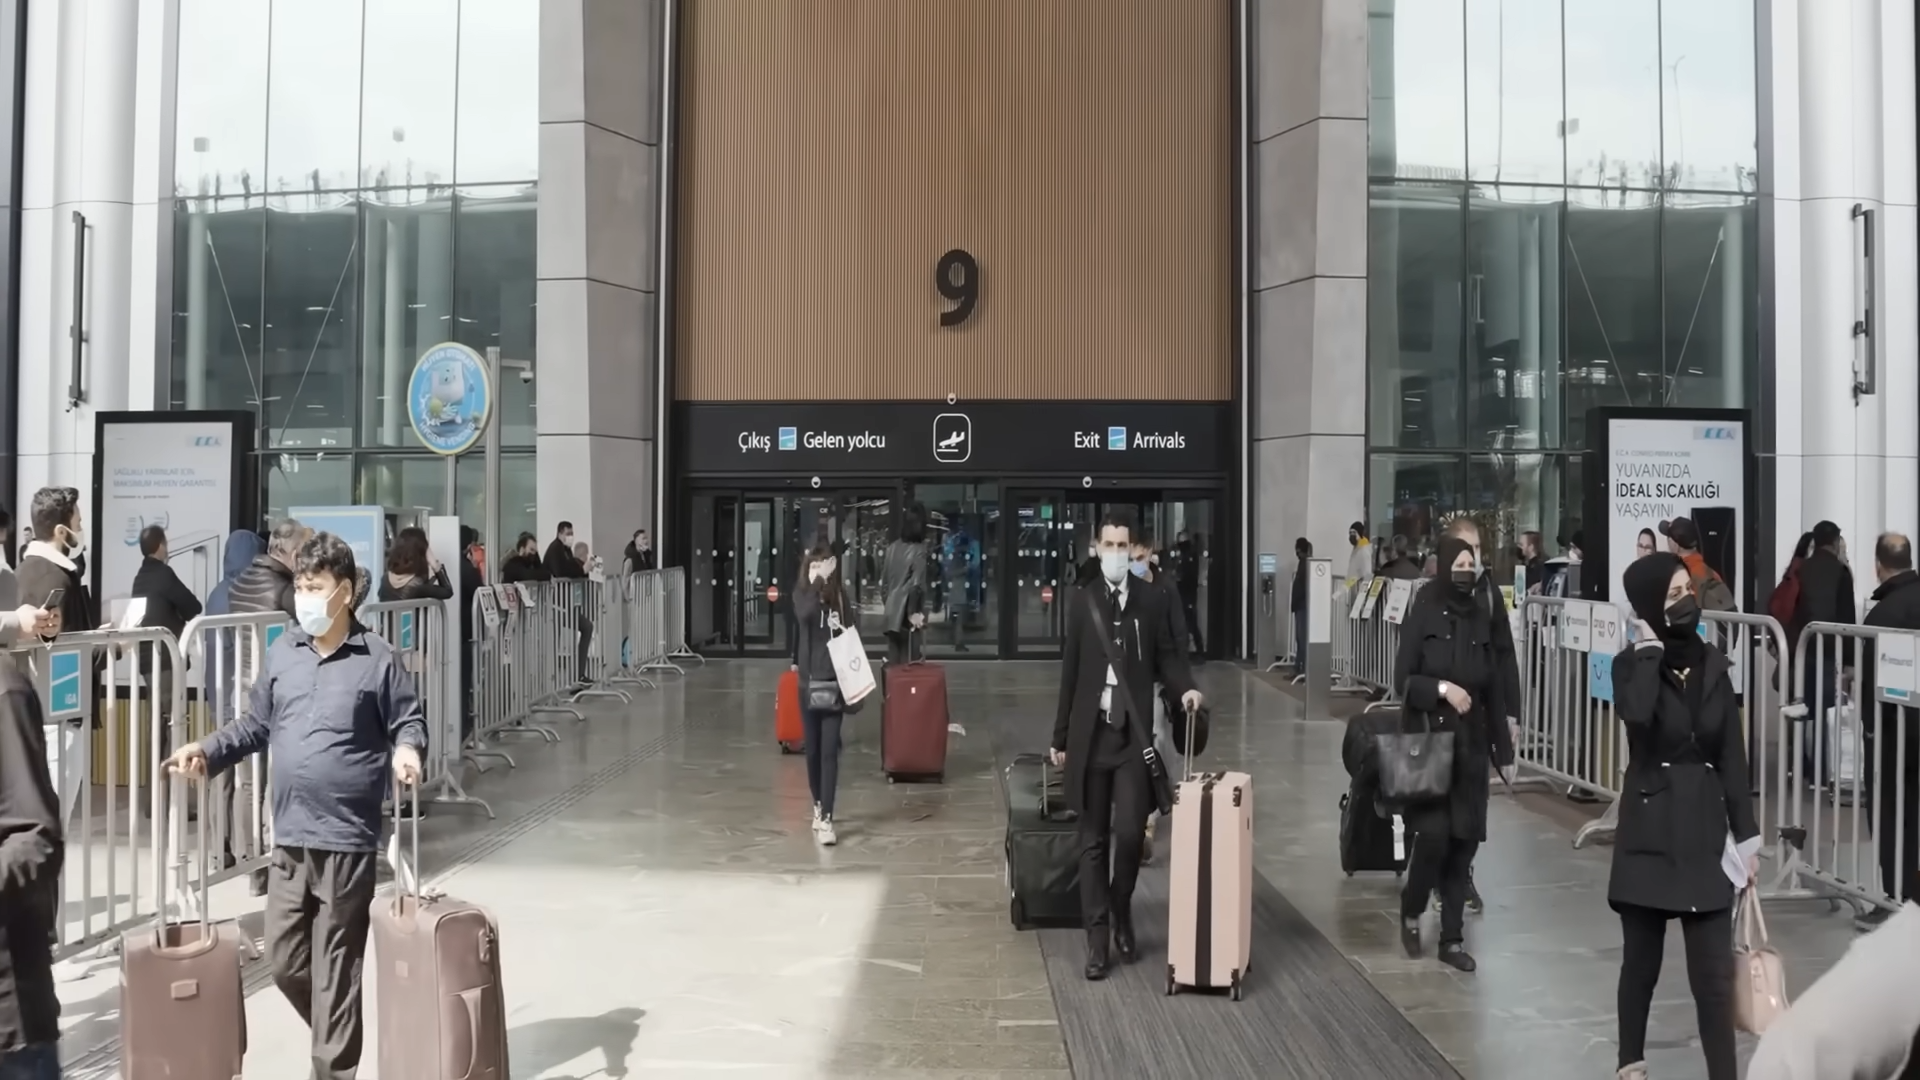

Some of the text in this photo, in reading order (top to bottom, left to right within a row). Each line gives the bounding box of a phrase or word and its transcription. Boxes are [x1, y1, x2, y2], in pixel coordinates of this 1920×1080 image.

[936, 249, 978, 327] 9
[738, 431, 886, 453] Çıkış Gelen yolcu
[1074, 431, 1185, 448] Exit Arrivals
[1615, 463, 1691, 479] YUVANIZDA
[1616, 479, 1720, 499] İDEAL SICAKLIĞI
[1615, 503, 1674, 522] YAŞAYIN!
